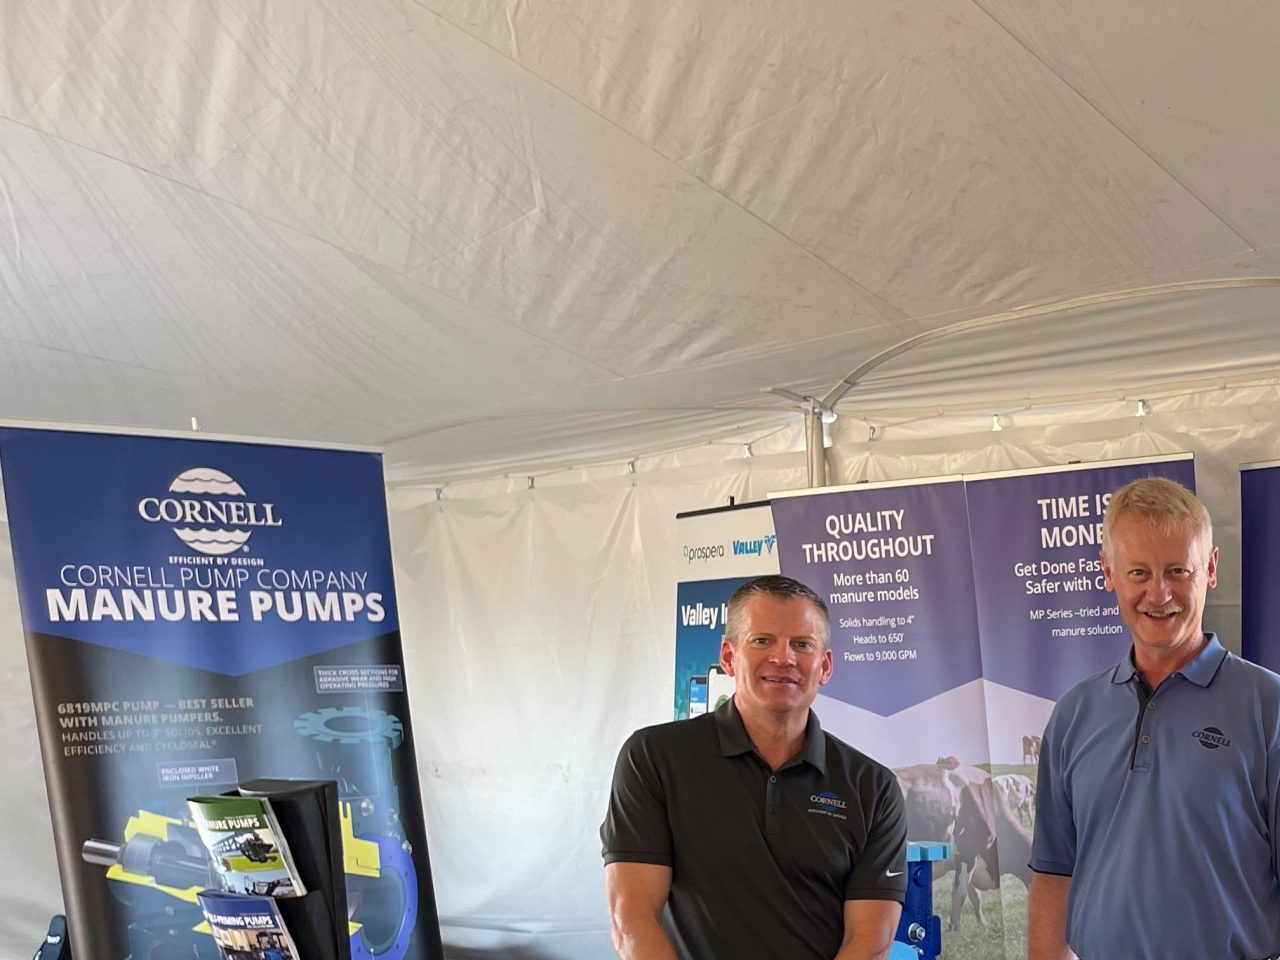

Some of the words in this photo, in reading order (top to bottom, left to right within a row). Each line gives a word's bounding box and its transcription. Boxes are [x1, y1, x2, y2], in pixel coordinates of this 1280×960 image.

[138, 497, 283, 527] CORNELL
[1037, 495, 1090, 521] TIME
[1095, 493, 1113, 516] IS
[825, 509, 905, 539] QUALITY
[1040, 523, 1104, 549] MONE
[688, 544, 725, 565] prospera
[801, 534, 935, 564] THROUGHOUT
[168, 555, 215, 566] EFFICIENT
[216, 556, 229, 566] BY
[231, 557, 264, 567] DESIGN
[1014, 561, 1038, 577] Get
[1040, 559, 1076, 576] Done
[1078, 558, 1104, 573] Fas
[60, 564, 175, 589] CORNELL
[180, 567, 249, 589] PUMP
[256, 569, 368, 591] COMPANY
[833, 571, 863, 587] More
[865, 569, 893, 585] than
[895, 568, 910, 583] 60
[1025, 579, 1060, 595] Safer
[1063, 577, 1092, 592] with
[829, 589, 875, 604] manure
[877, 585, 919, 601] models
[45, 588, 240, 622] MANURE
[250, 590, 386, 622] PUMPS
[1029, 610, 1045, 620] MP
[1046, 609, 1074, 619] Series
[1102, 605, 1120, 617] and
[681, 602, 719, 630] Valley
[839, 617, 861, 628] Solids
[862, 615, 896, 629] handling
[897, 616, 906, 626] to
[853, 633, 877, 645] Heads
[878, 634, 887, 644] to
[1051, 627, 1086, 638] manure
[1087, 624, 1123, 636] solution
[844, 651, 866, 662] Flows
[866, 651, 875, 661] to
[875, 650, 898, 662] 9,000
[898, 649, 917, 661] GPM
[57, 700, 120, 715] 6819MPC
[123, 700, 160, 712] PUMP
[178, 698, 207, 711] BEST
[210, 697, 254, 710] SELLER
[58, 715, 98, 729] WITH
[101, 713, 158, 727] MANURE
[160, 711, 224, 724] PUMPERS.
[62, 729, 116, 743] HANDLES
[206, 724, 263, 736] EXCELLENT
[1192, 730, 1231, 747] CORNELL
[63, 742, 127, 758] EFFICIENCY
[810, 794, 847, 809] CORNELL
